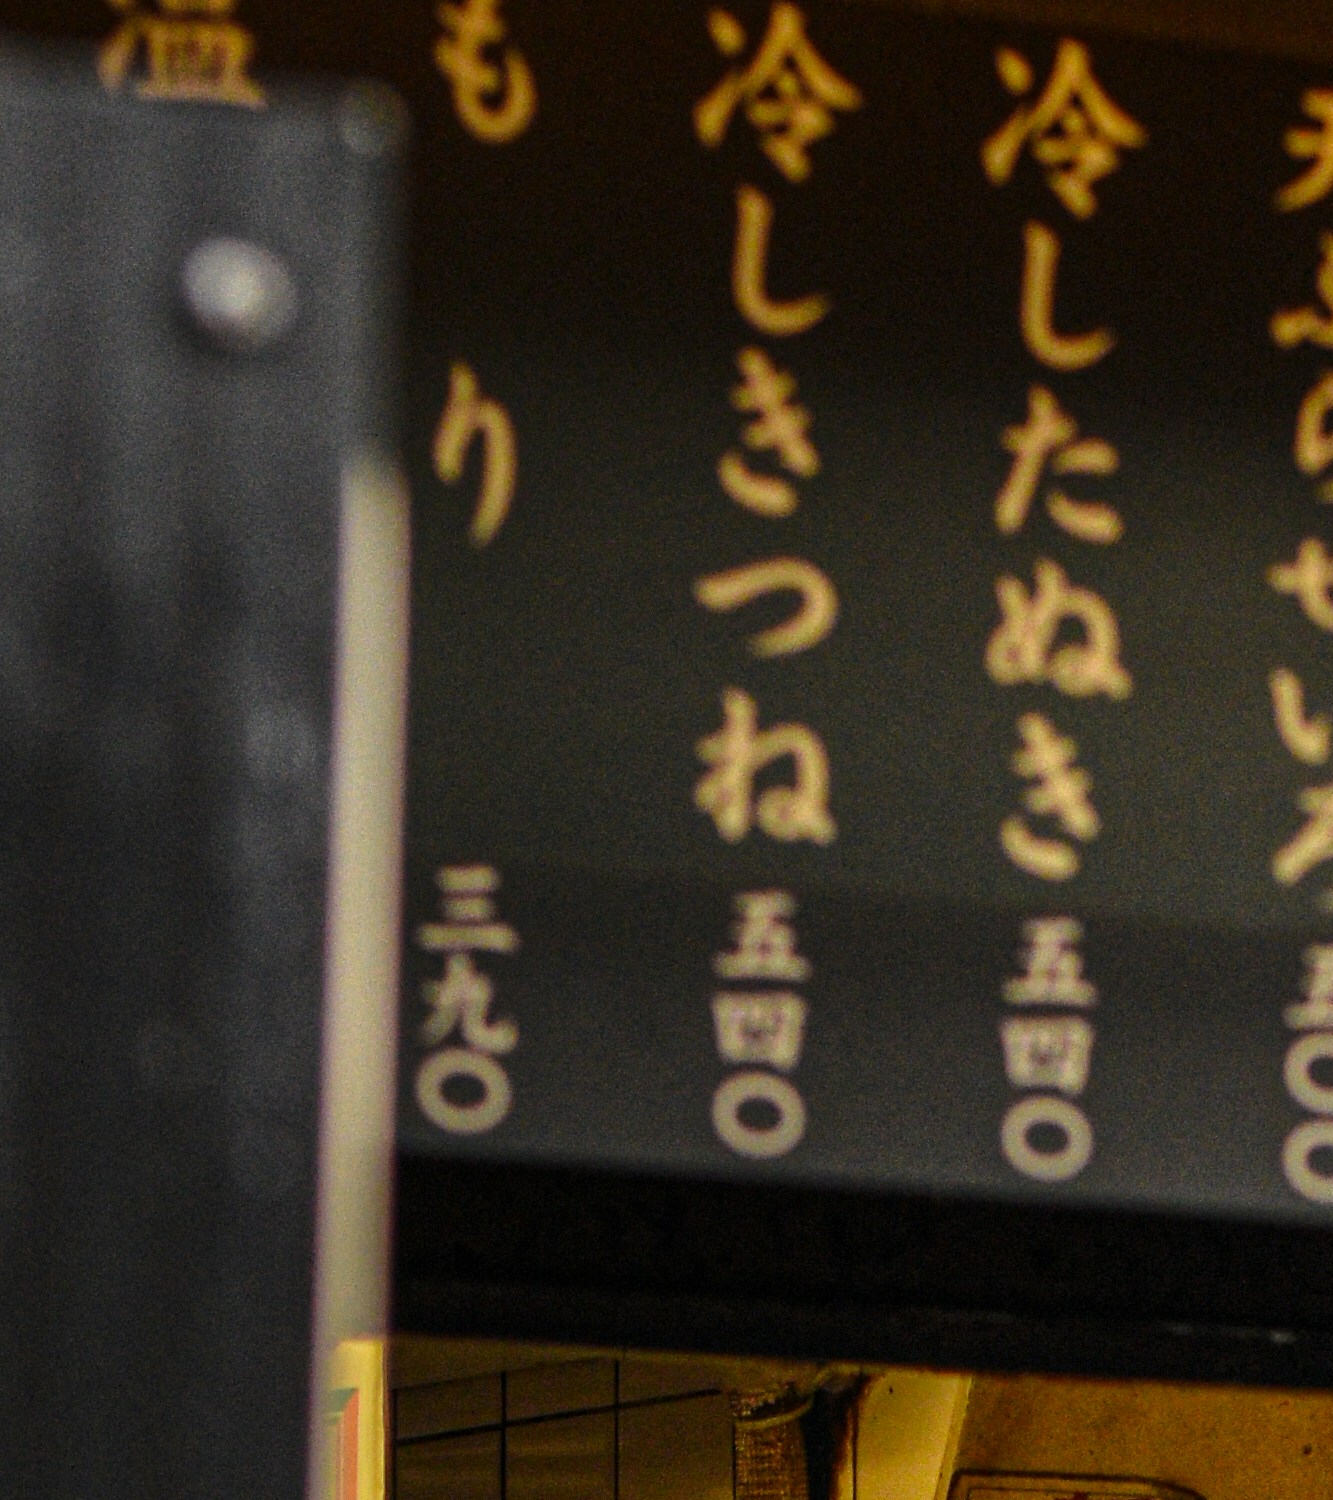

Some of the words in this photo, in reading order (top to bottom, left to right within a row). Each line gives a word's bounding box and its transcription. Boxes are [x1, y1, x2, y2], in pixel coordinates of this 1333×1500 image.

[696, 3, 856, 843] 冷しきつね
[985, 41, 1139, 879] 冷したぬき
